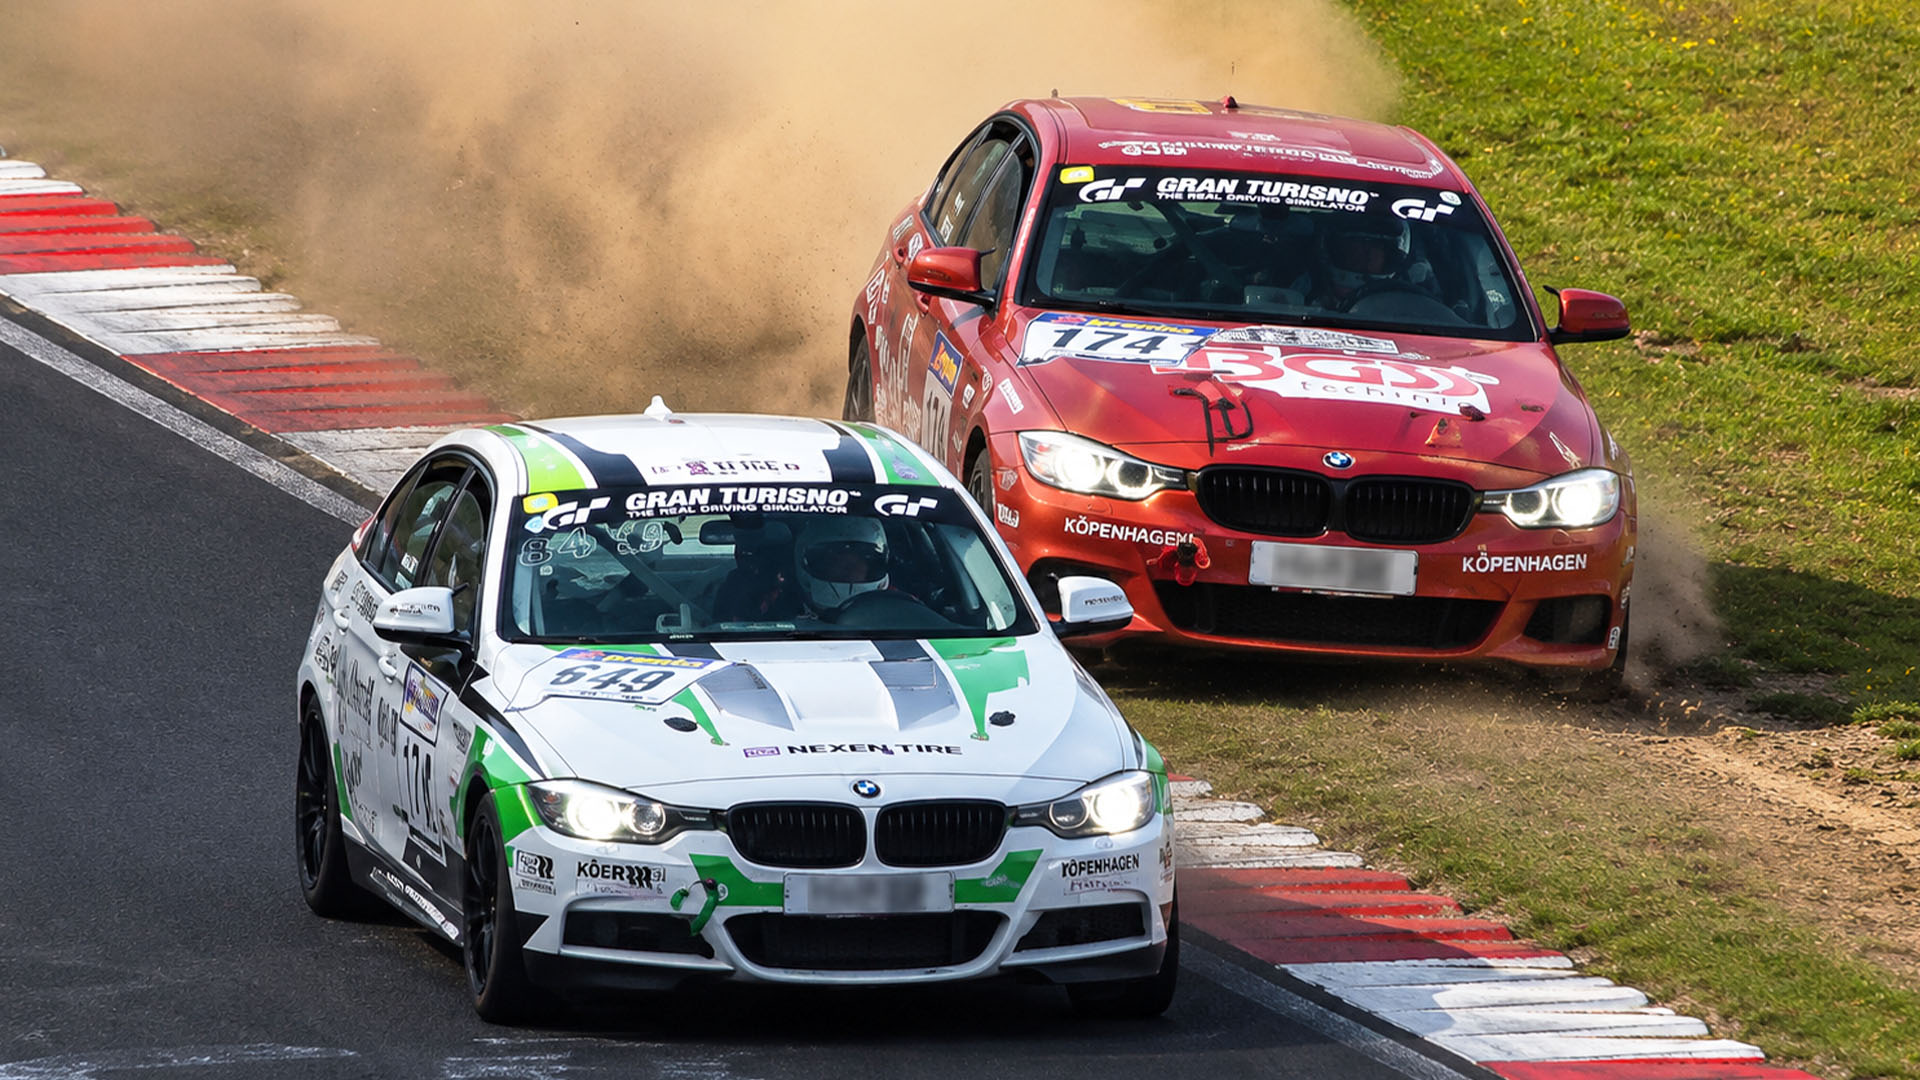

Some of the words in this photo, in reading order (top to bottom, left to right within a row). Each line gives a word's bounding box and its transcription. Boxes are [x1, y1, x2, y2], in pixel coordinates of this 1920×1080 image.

[1157, 177, 1239, 195] GRAN
[1156, 192, 1184, 200] THE
[1187, 192, 1223, 201] REAL
[1226, 194, 1281, 204] DRIVING
[1285, 197, 1366, 212] SIMULATOR
[1052, 327, 1168, 354] 174
[625, 487, 711, 511] GRAN
[626, 510, 653, 518] THE
[700, 504, 757, 513] DRIVING
[1462, 552, 1587, 574] KÖPENHAGEN
[550, 664, 675, 693] 649
[787, 744, 890, 755] NEXEN
[895, 744, 963, 755] TIRE
